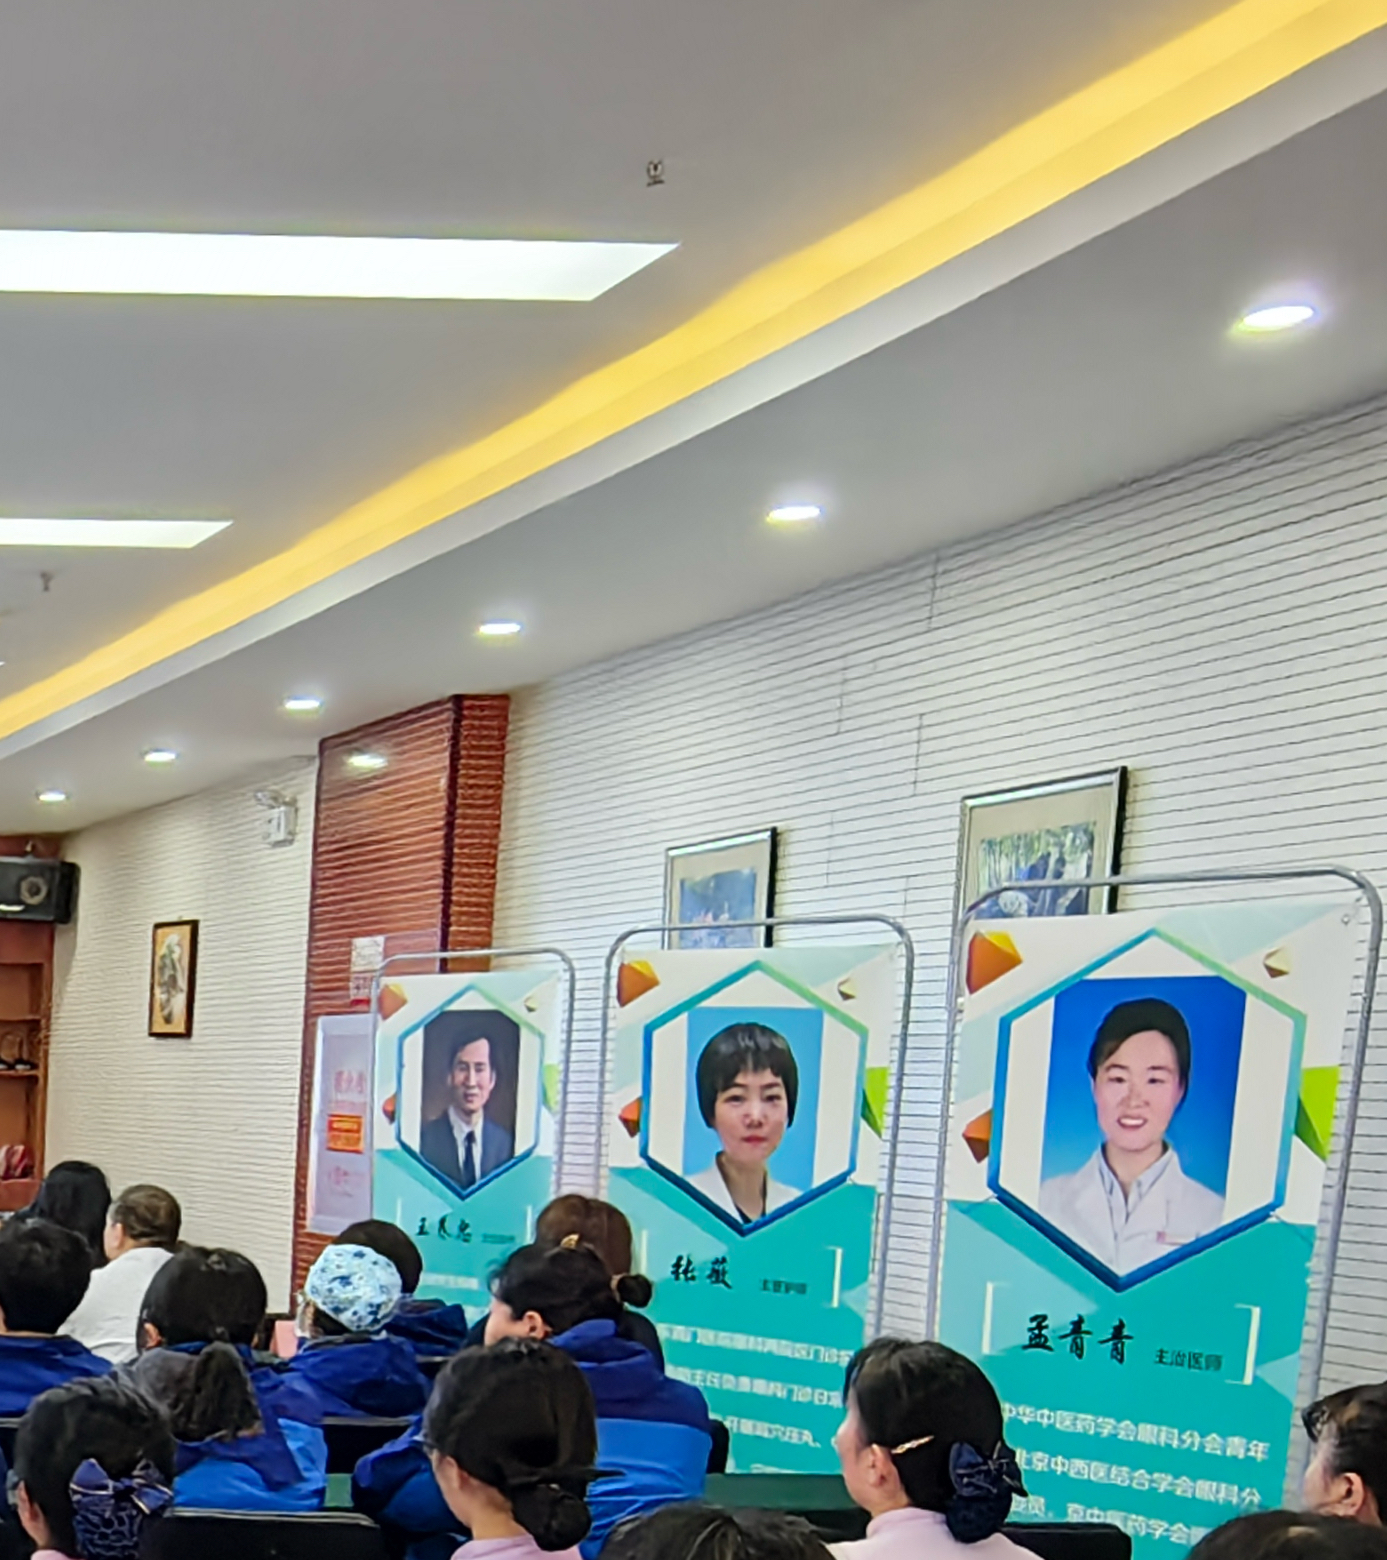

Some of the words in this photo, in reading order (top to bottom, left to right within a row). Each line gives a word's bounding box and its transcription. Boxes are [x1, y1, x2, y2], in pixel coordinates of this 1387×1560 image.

[1021, 1313, 1134, 1365] 孟青青
[1154, 1348, 1223, 1372] 主治医师
